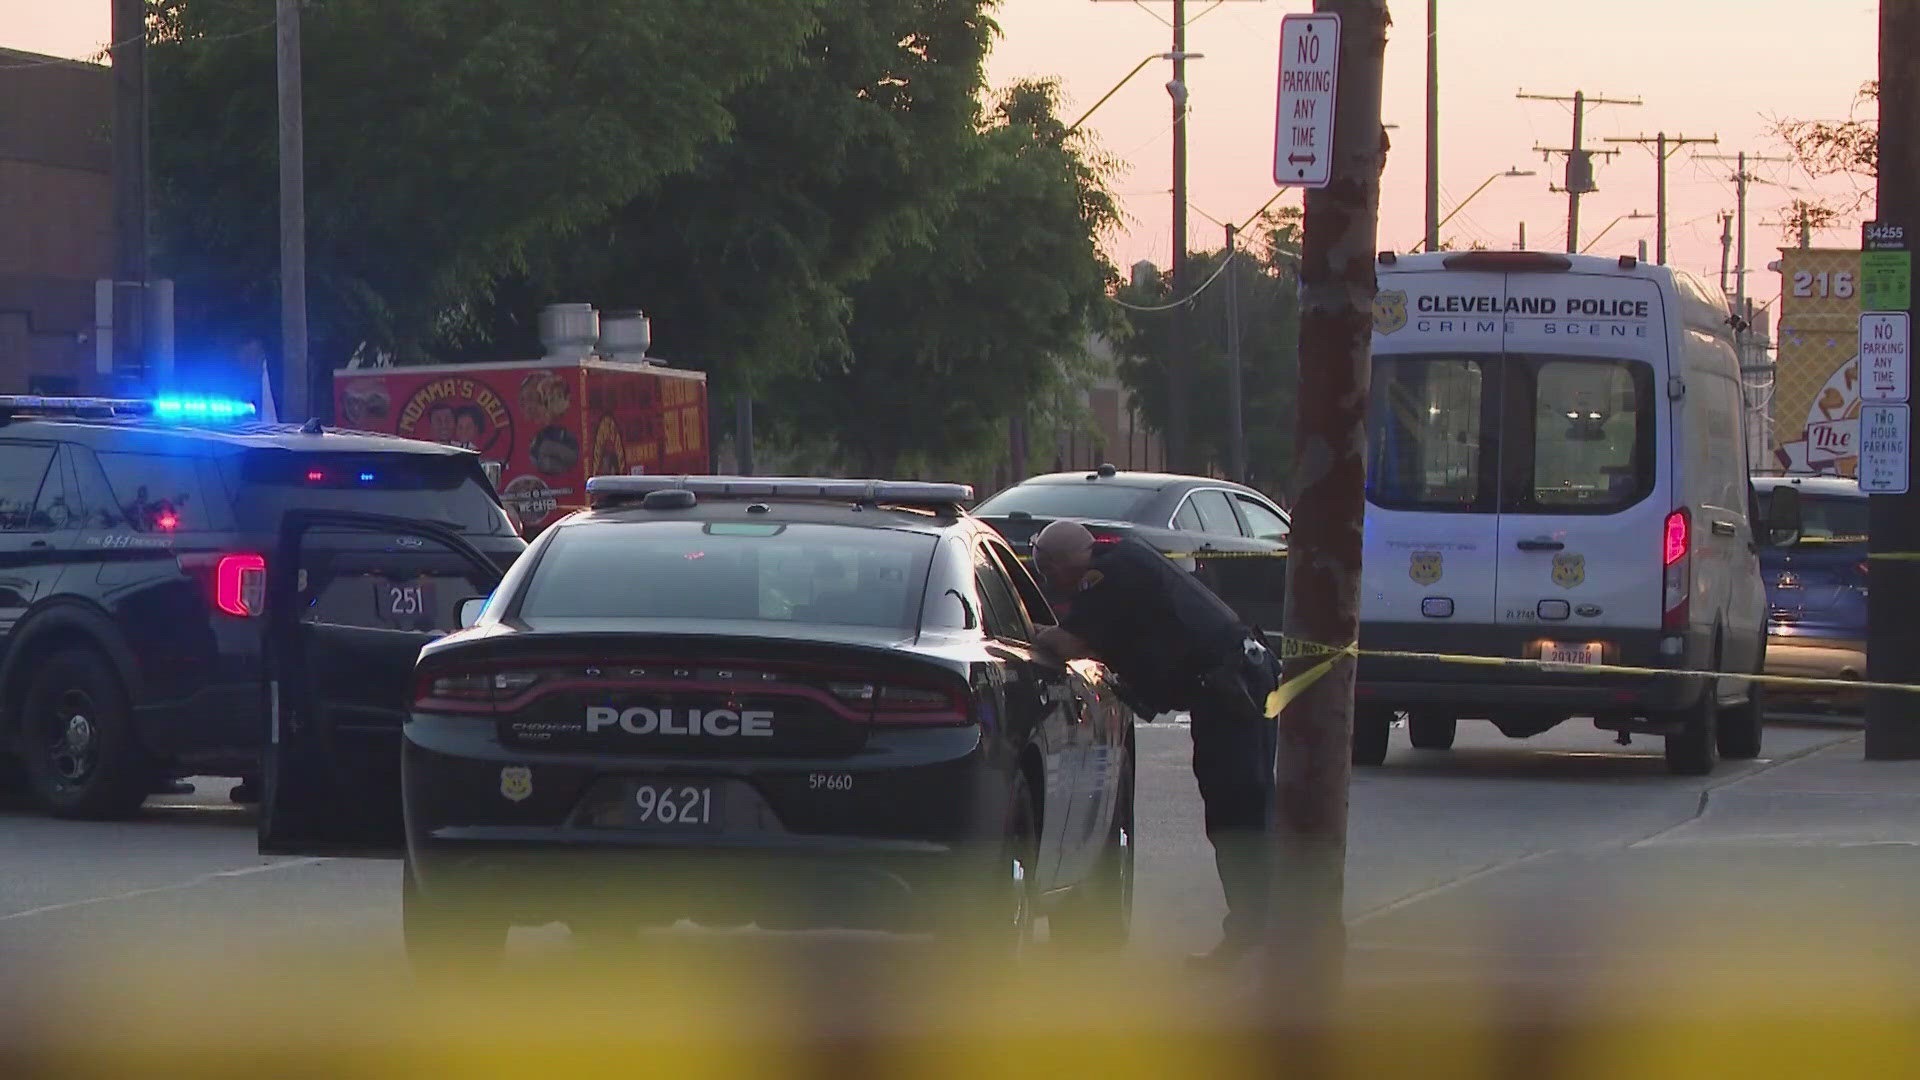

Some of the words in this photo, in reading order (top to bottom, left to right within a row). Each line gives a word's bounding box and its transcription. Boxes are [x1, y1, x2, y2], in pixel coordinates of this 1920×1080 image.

[1297, 35, 1320, 64] NO
[1283, 71, 1331, 92] PARKING
[1293, 99, 1317, 119] ANY
[1291, 127, 1316, 147] TIME
[1867, 226, 1904, 239] 34255
[1793, 271, 1854, 299] 216
[1417, 295, 1556, 315] CLEVELAND
[1566, 298, 1649, 318] POLICE
[1417, 320, 1515, 334] CRIME
[1544, 323, 1647, 338] SCENE
[1874, 323, 1893, 340] NO
[1863, 342, 1904, 354] PARKING
[1873, 357, 1893, 368] ANY
[1873, 371, 1894, 382] TIME
[400, 379, 475, 432] MOMMA'S
[477, 388, 511, 429] DELI
[1875, 412, 1895, 425] TWO
[1813, 425, 1852, 448] The
[1871, 426, 1897, 438] HOUR
[1863, 440, 1903, 453] PARKING
[390, 587, 423, 614] 251
[586, 706, 775, 737] POLICE
[809, 773, 853, 790] 5P660
[635, 785, 712, 824] 9621
